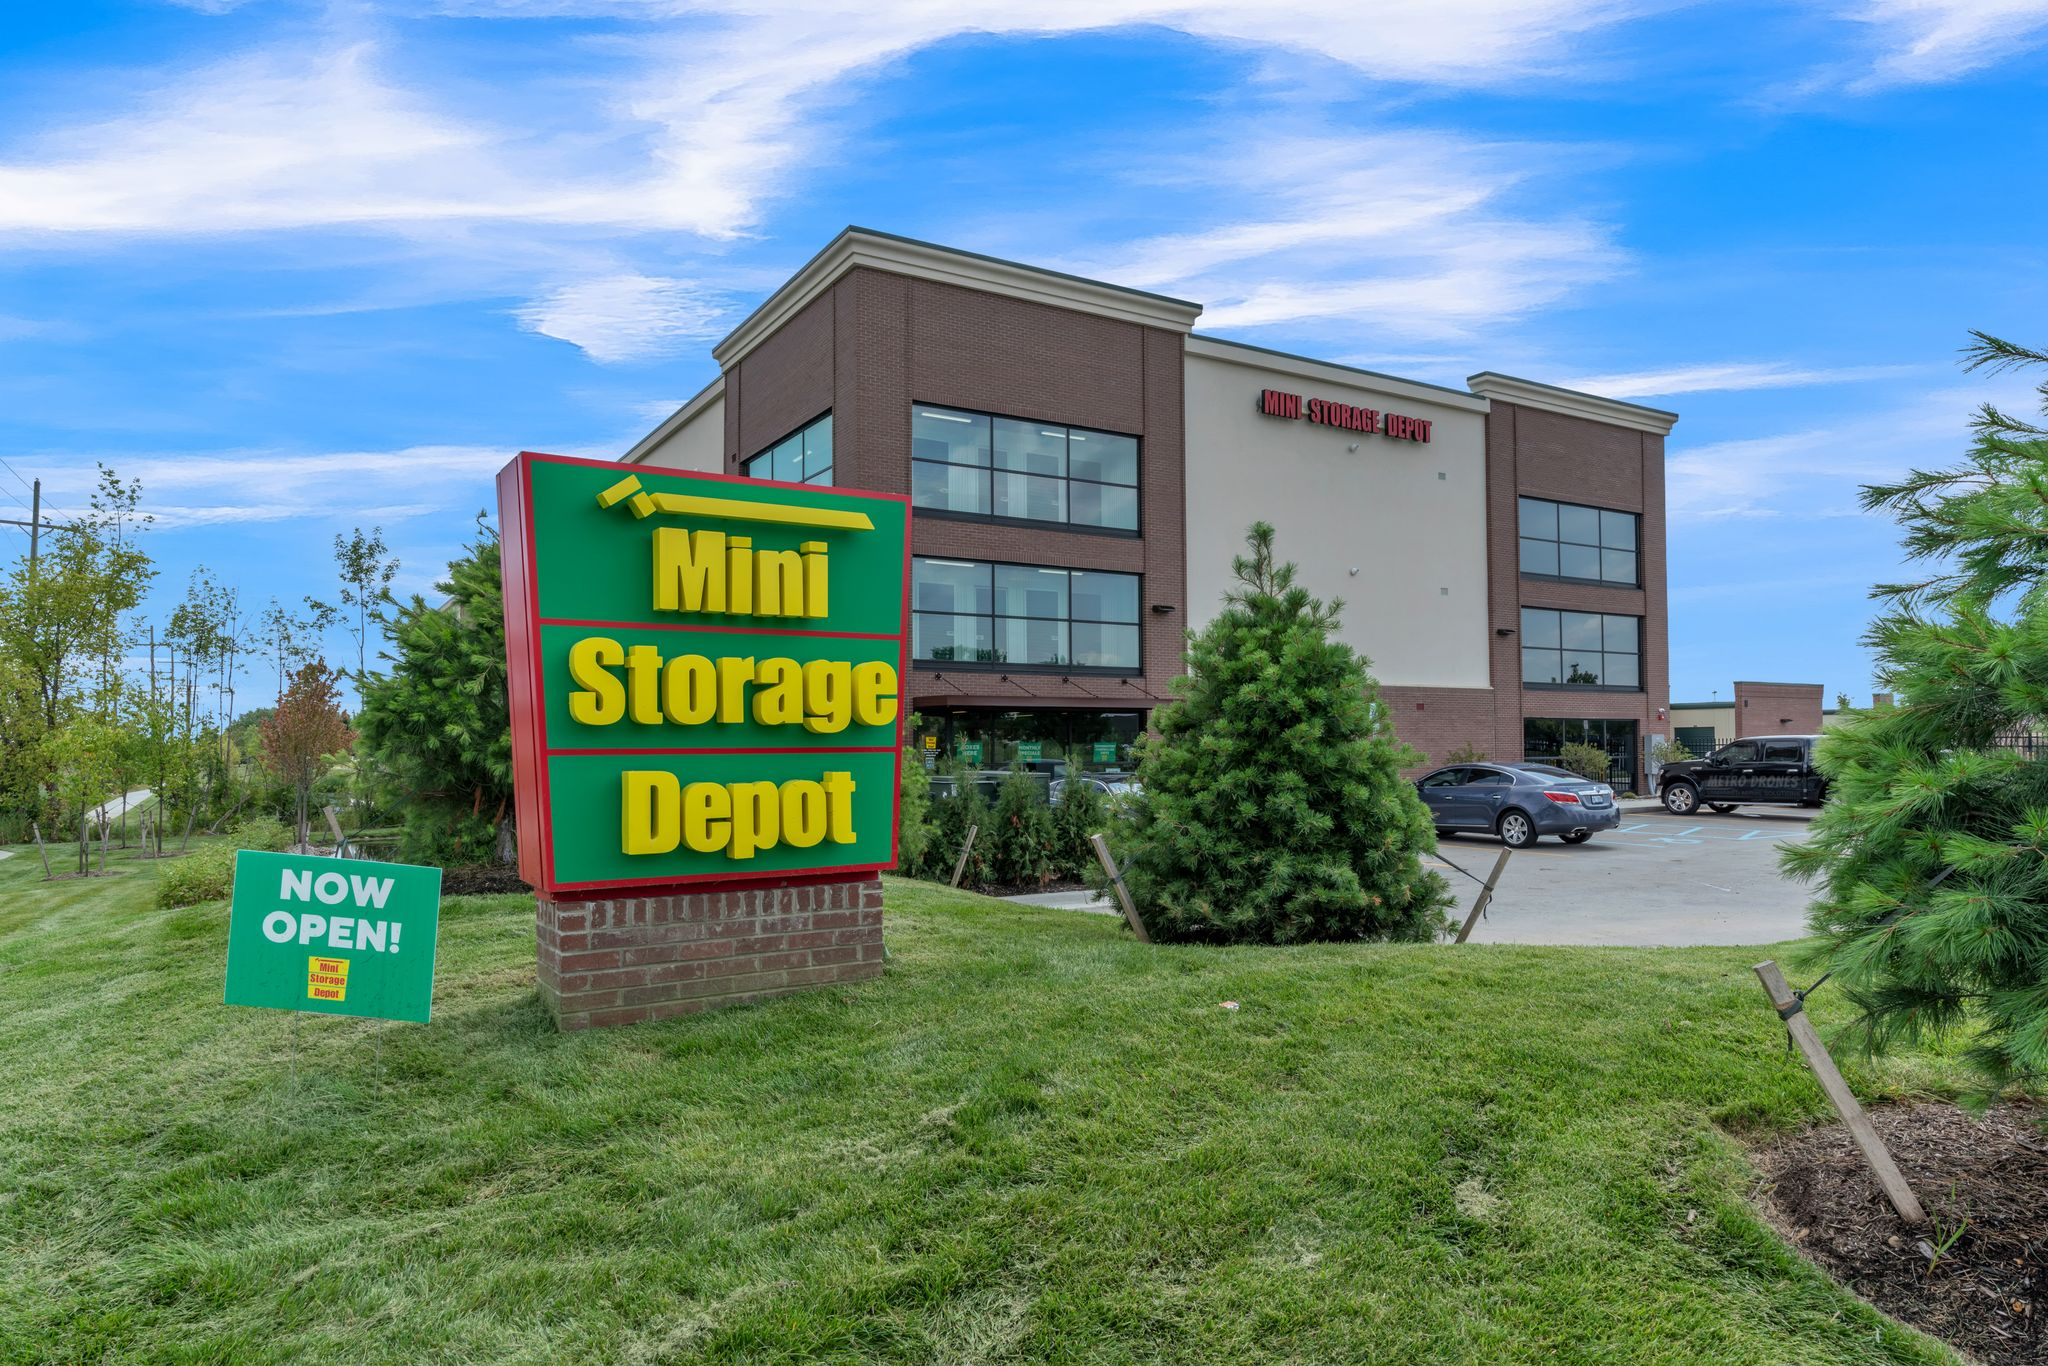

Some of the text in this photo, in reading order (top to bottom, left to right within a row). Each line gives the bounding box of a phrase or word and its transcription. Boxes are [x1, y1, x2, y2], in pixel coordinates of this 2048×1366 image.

[1262, 389, 1432, 443] MINI STORAGE DEPOT
[652, 527, 828, 618] Mini
[568, 637, 898, 734] Storage
[1707, 775, 1800, 788] METRO DRONES
[621, 770, 856, 859] Depot
[280, 868, 395, 909] NOW
[262, 910, 402, 954] OPEN!
[310, 973, 345, 986] Storage
[319, 962, 339, 973] Mini
[314, 987, 339, 999] Depot
